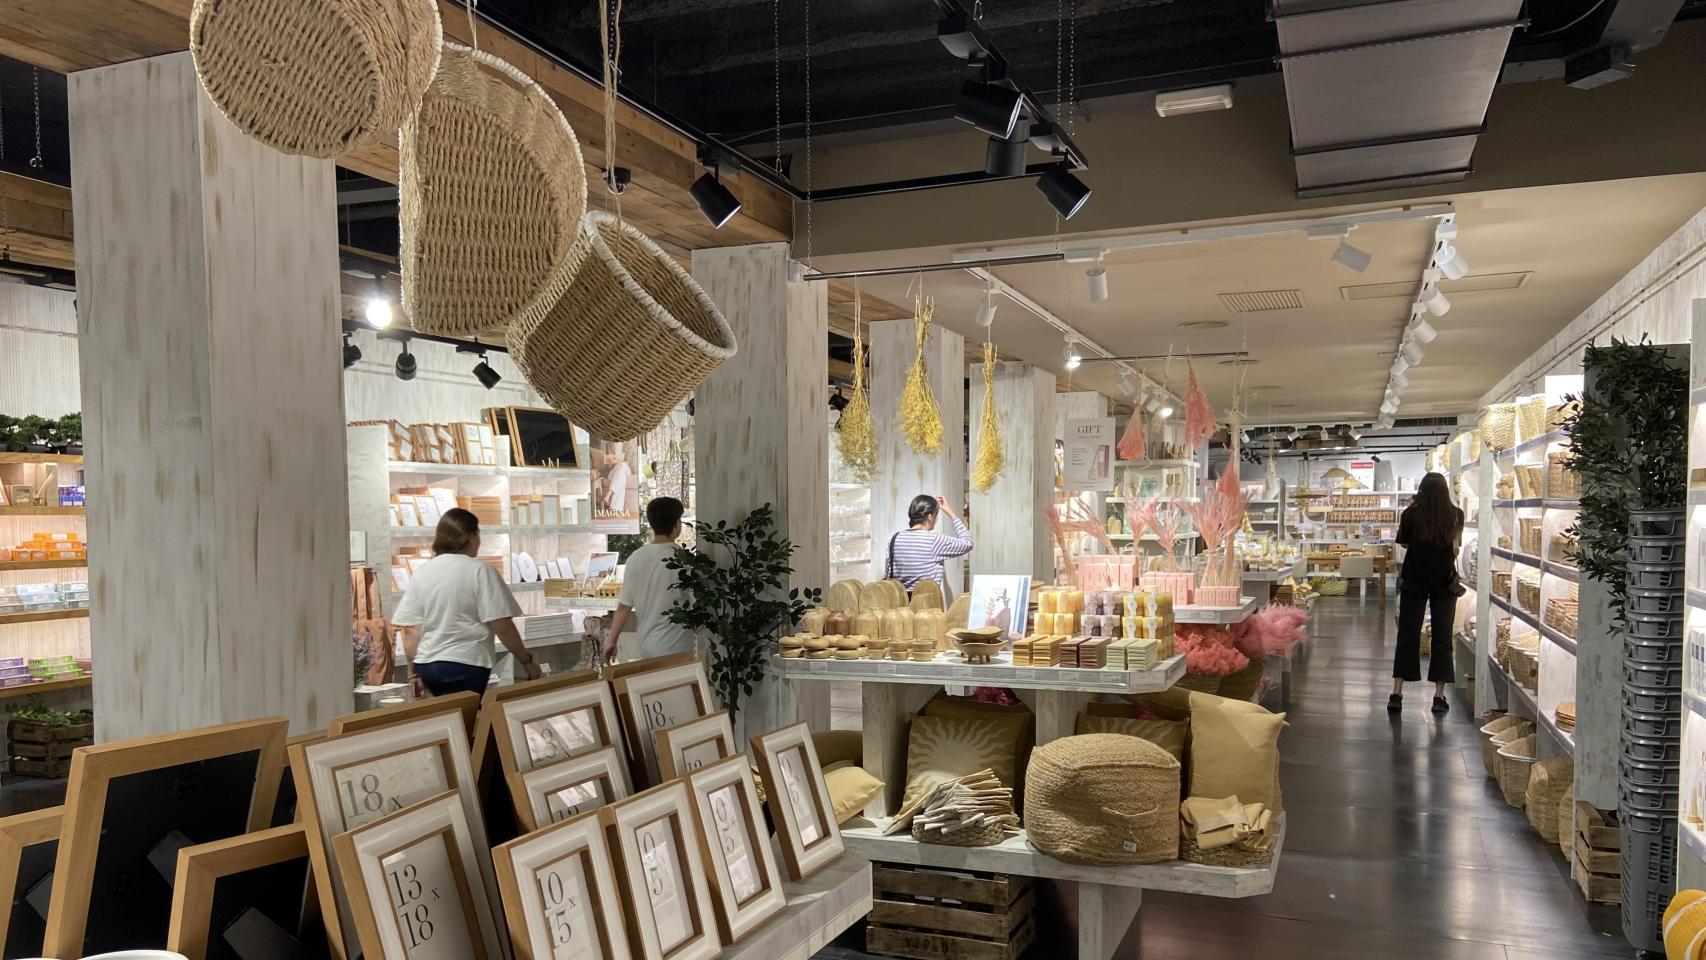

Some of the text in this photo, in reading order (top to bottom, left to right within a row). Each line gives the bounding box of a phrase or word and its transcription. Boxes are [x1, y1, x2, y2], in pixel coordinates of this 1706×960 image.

[1077, 425, 1102, 433] GIFT
[594, 509, 630, 518] IMAGINA
[644, 700, 666, 730] 18
[341, 774, 403, 819] 18 x
[390, 864, 441, 908] 13 x
[400, 904, 434, 950] 18
